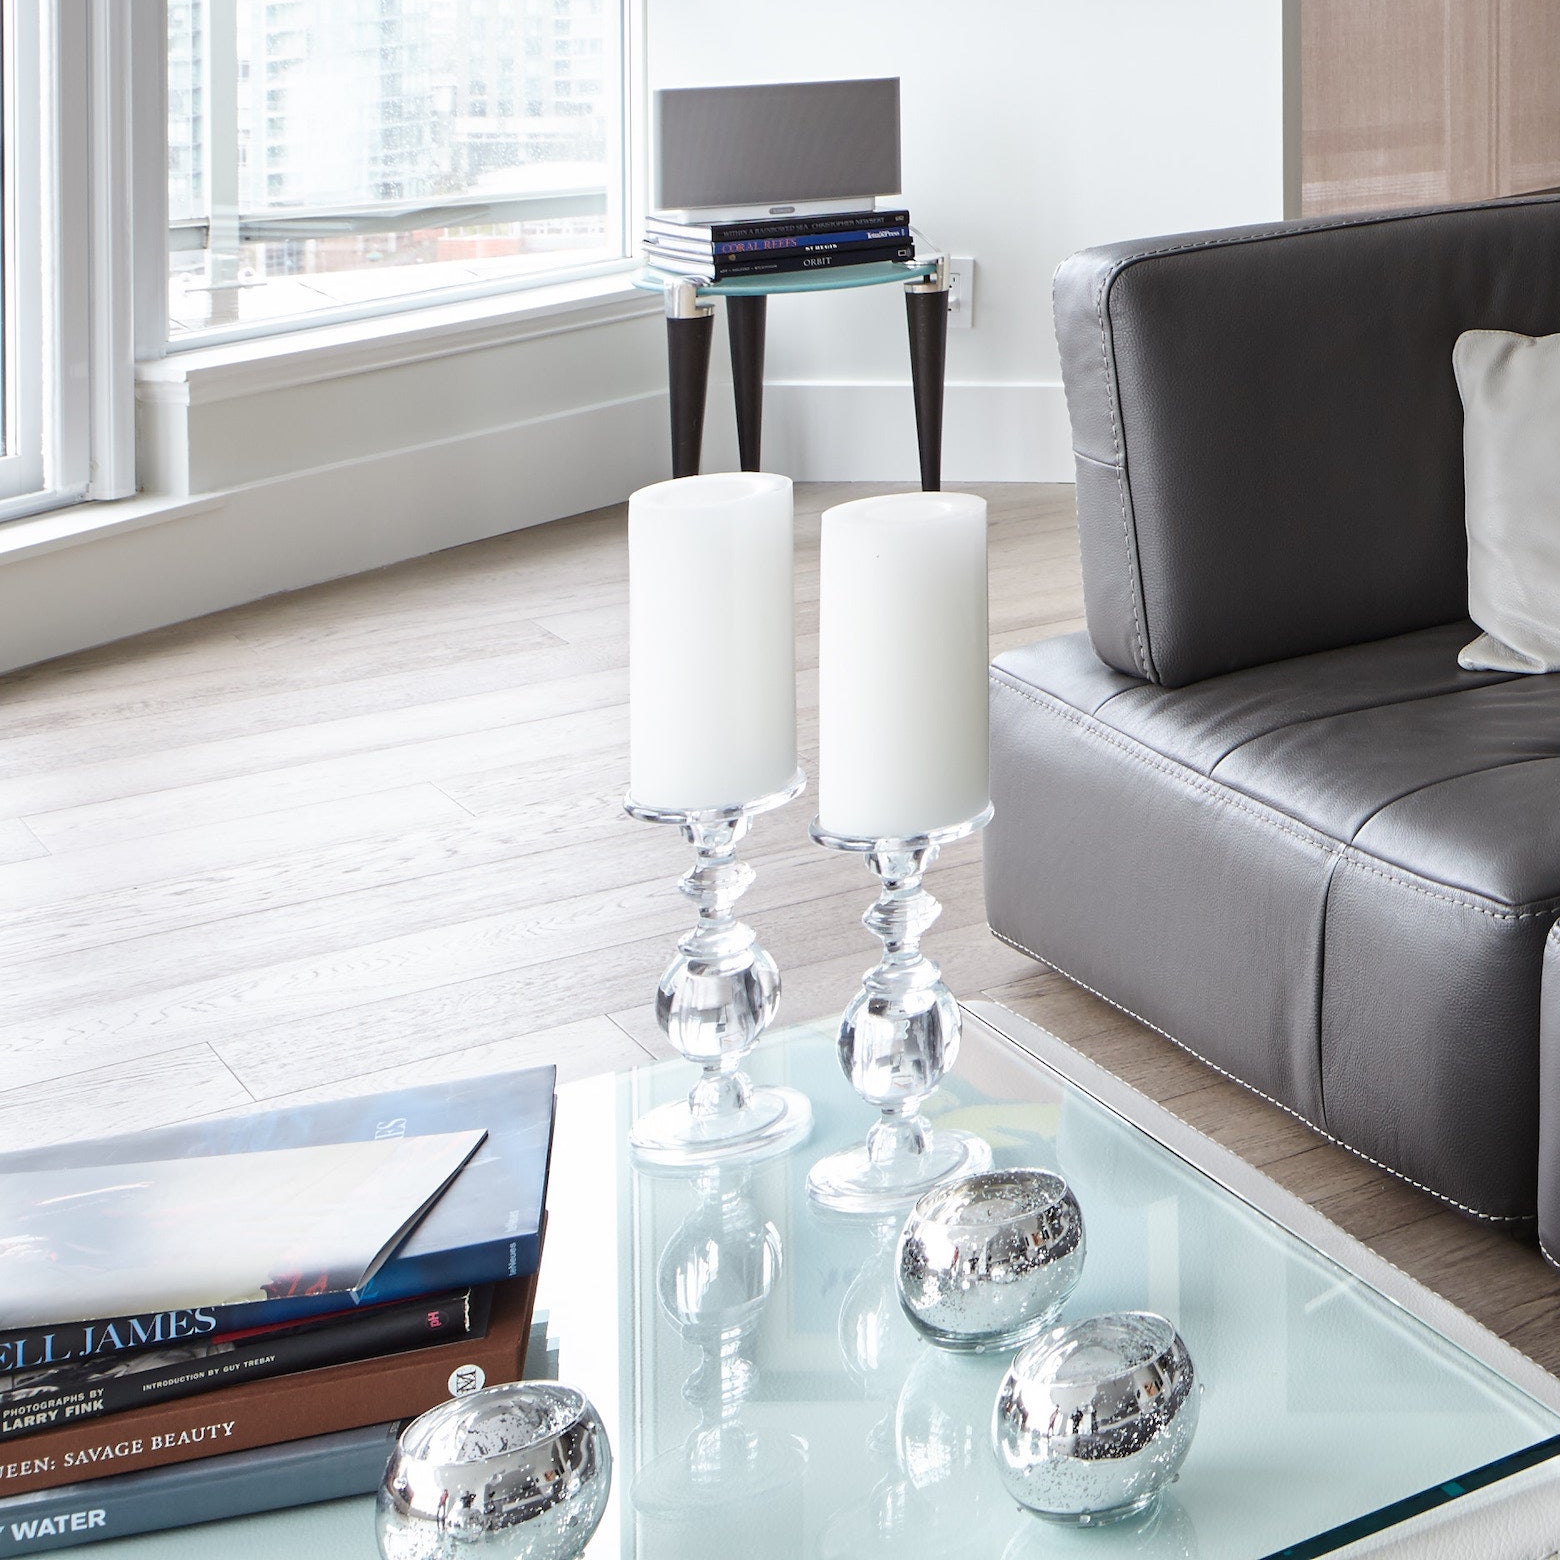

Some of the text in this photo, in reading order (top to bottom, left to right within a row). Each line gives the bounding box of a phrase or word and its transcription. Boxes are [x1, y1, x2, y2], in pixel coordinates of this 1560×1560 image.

[721, 237, 798, 253] CORAL REEFS
[802, 256, 833, 267] ORBIT
[79, 1306, 218, 1357] JAMES
[143, 1355, 276, 1391] INTRODUCTION BY GUY TREBAY
[2, 1398, 105, 1433] LARRY FINK
[3, 1387, 105, 1418] PHOTOGRAPHS BY
[63, 1439, 144, 1468] SAVAGE
[151, 1421, 236, 1451] BEAUTY
[11, 1508, 107, 1541] WATER
